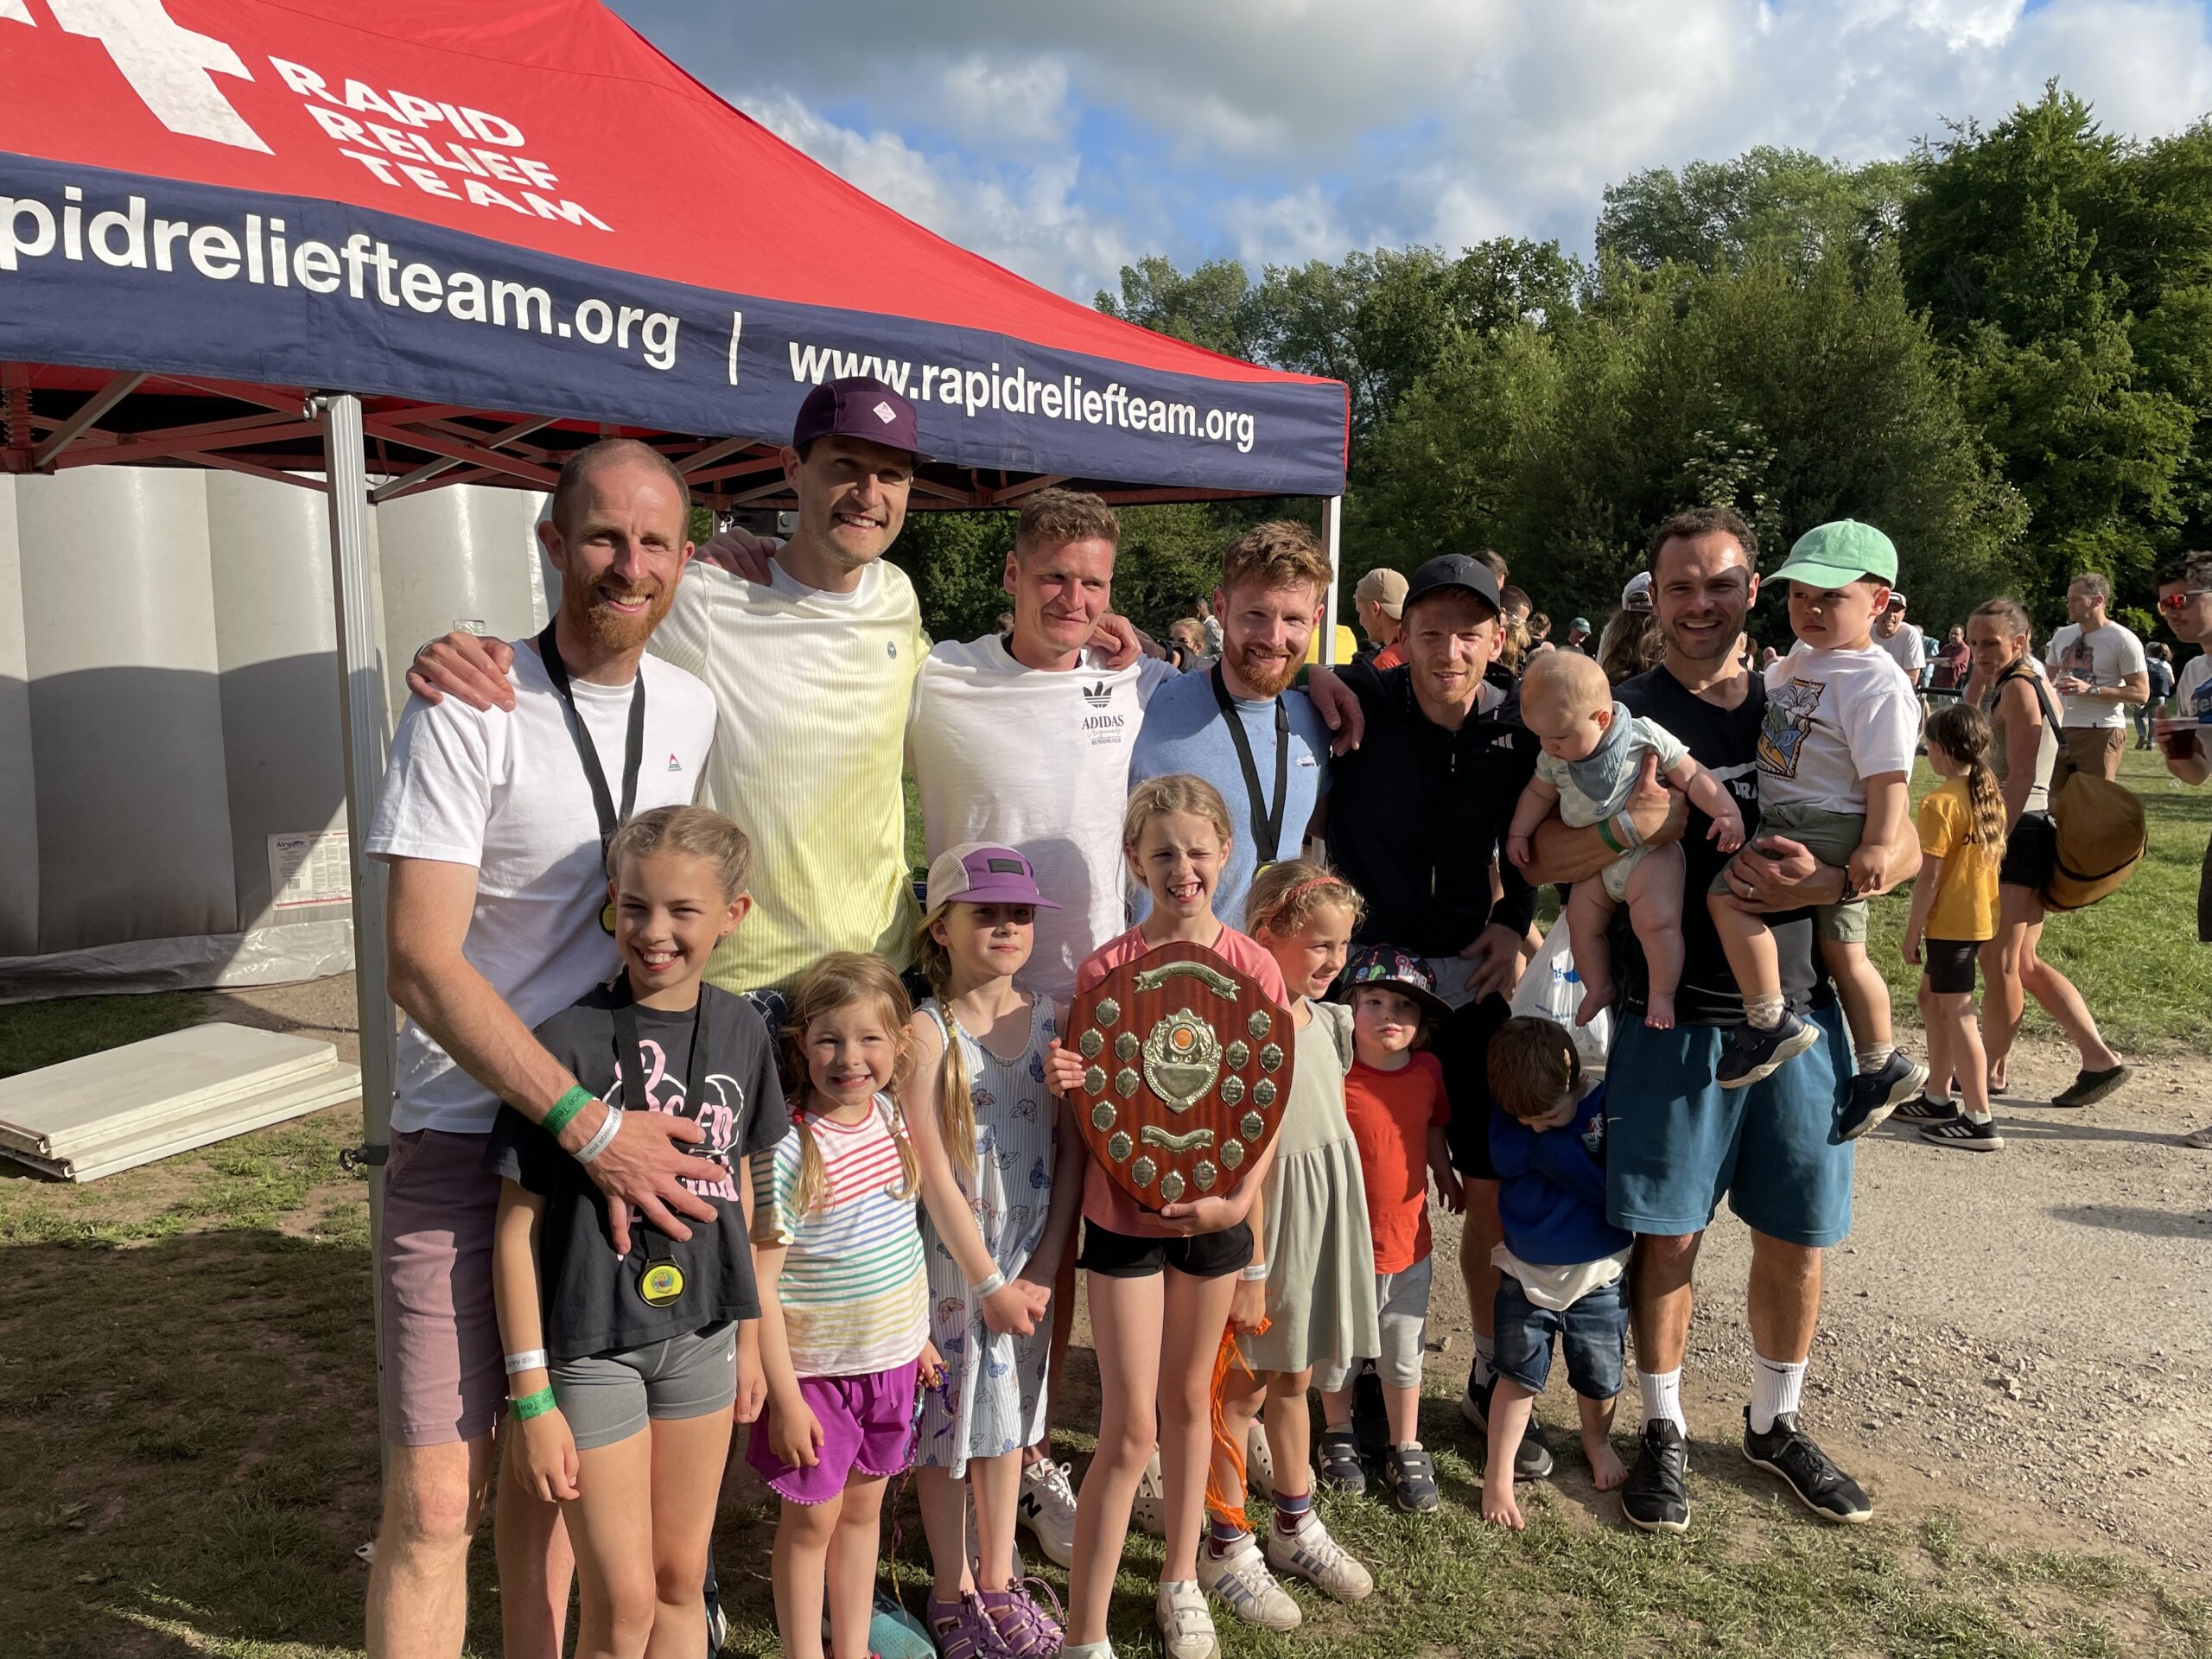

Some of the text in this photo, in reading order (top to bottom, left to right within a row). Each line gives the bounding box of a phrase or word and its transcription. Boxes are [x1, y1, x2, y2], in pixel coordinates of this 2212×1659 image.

[267, 55, 525, 147] RAPID
[303, 103, 560, 191] RELIEF
[338, 147, 615, 232] TEAM
[0, 186, 680, 371] pidreliefteam.org
[789, 341, 1255, 453] www.rapidreliefteam.org
[1082, 715, 1124, 729] ADIDAS
